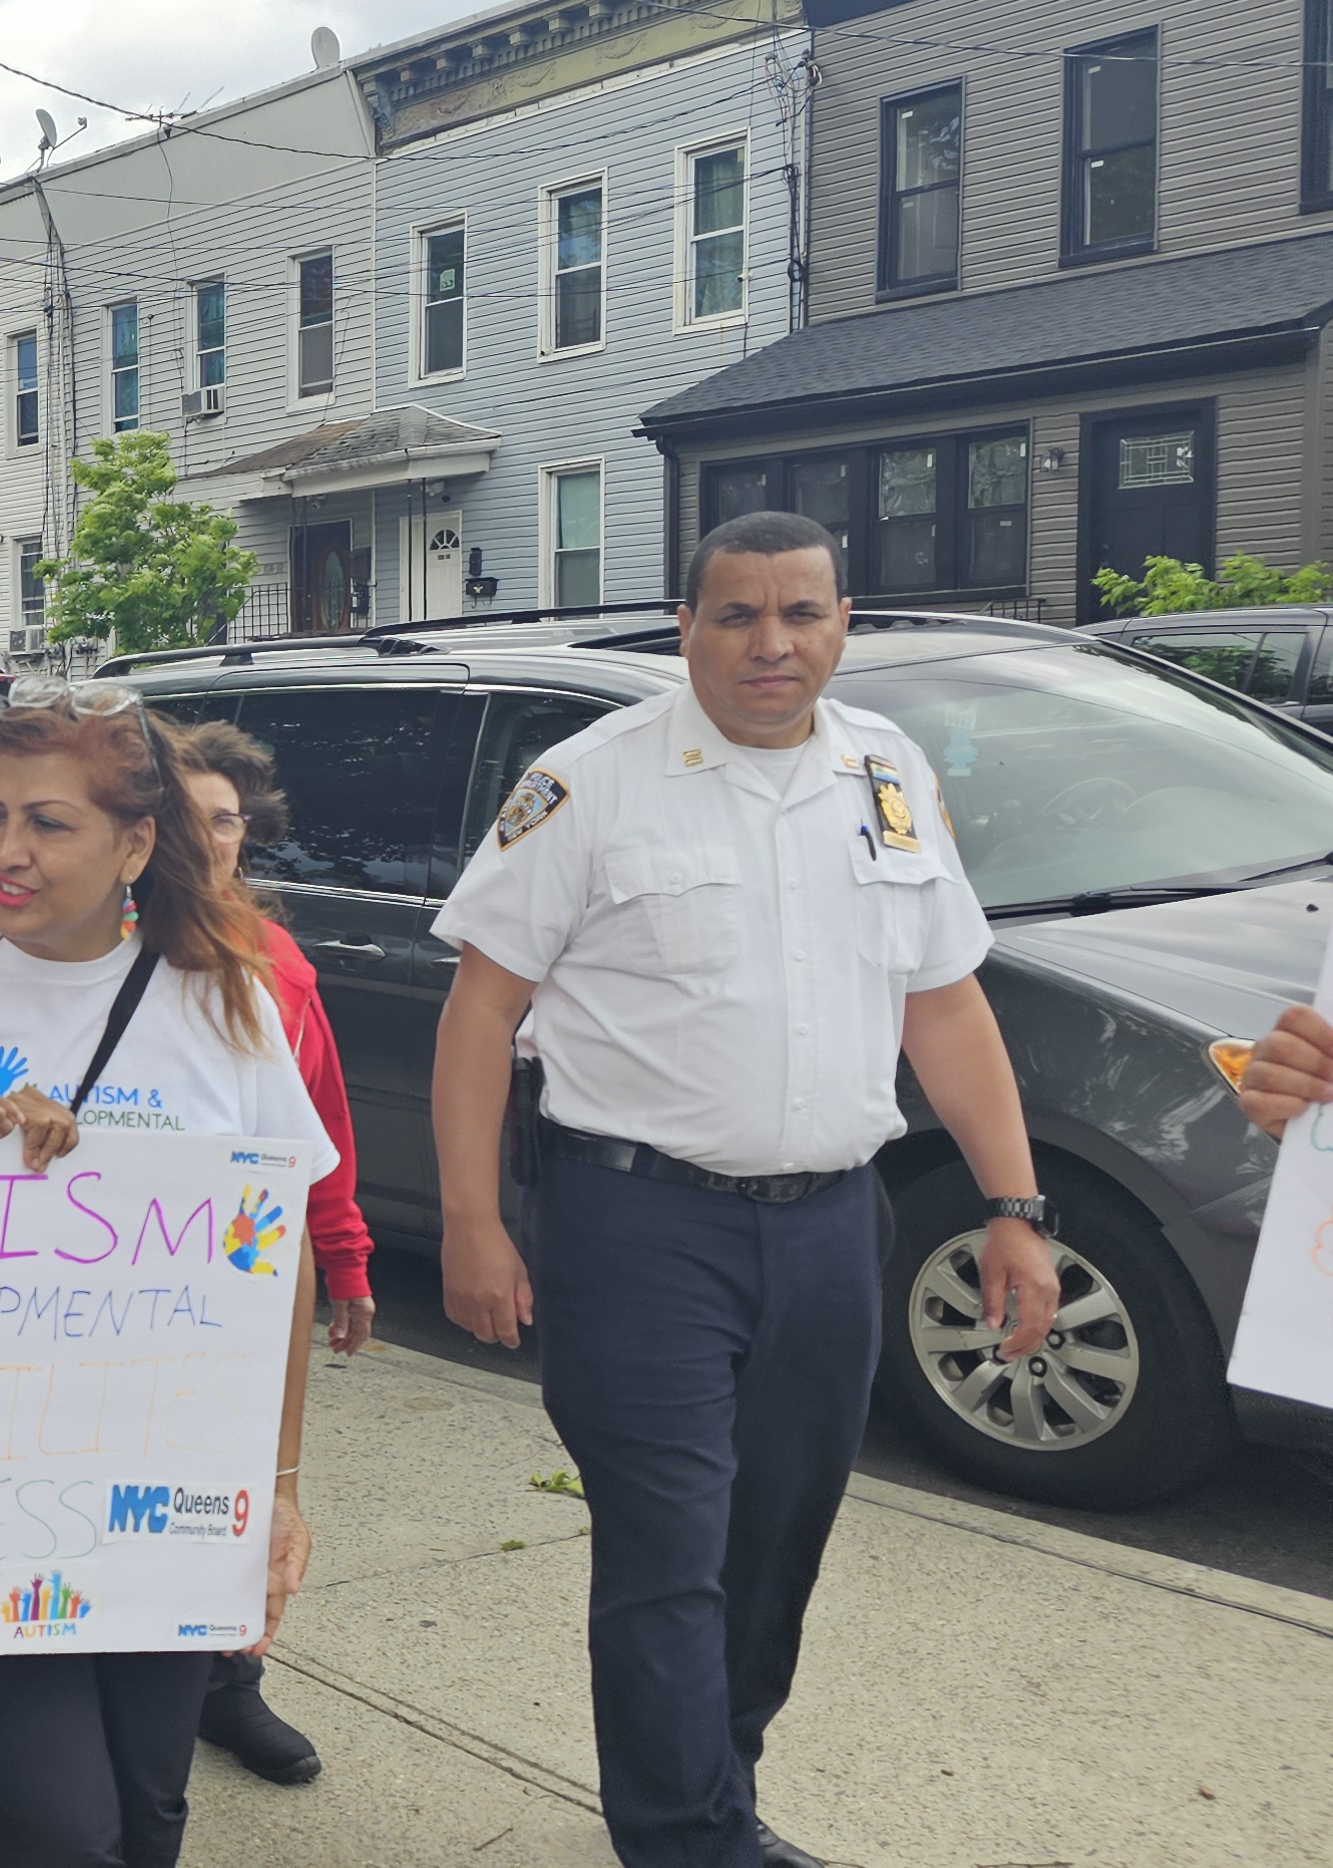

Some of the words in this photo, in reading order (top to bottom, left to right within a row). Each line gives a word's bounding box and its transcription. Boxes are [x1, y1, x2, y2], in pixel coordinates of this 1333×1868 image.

[147, 1089, 163, 1109] &
[230, 1151, 259, 1165] NYC
[288, 1156, 296, 1168] 9
[108, 1484, 170, 1533] NYC
[173, 1487, 229, 1515] Queens
[232, 1489, 249, 1537] 9
[169, 1522, 205, 1539] Community
[207, 1523, 227, 1536] Board
[13, 1623, 76, 1639] AUTISM
[178, 1624, 207, 1636] NYC
[239, 1624, 247, 1636] 9
